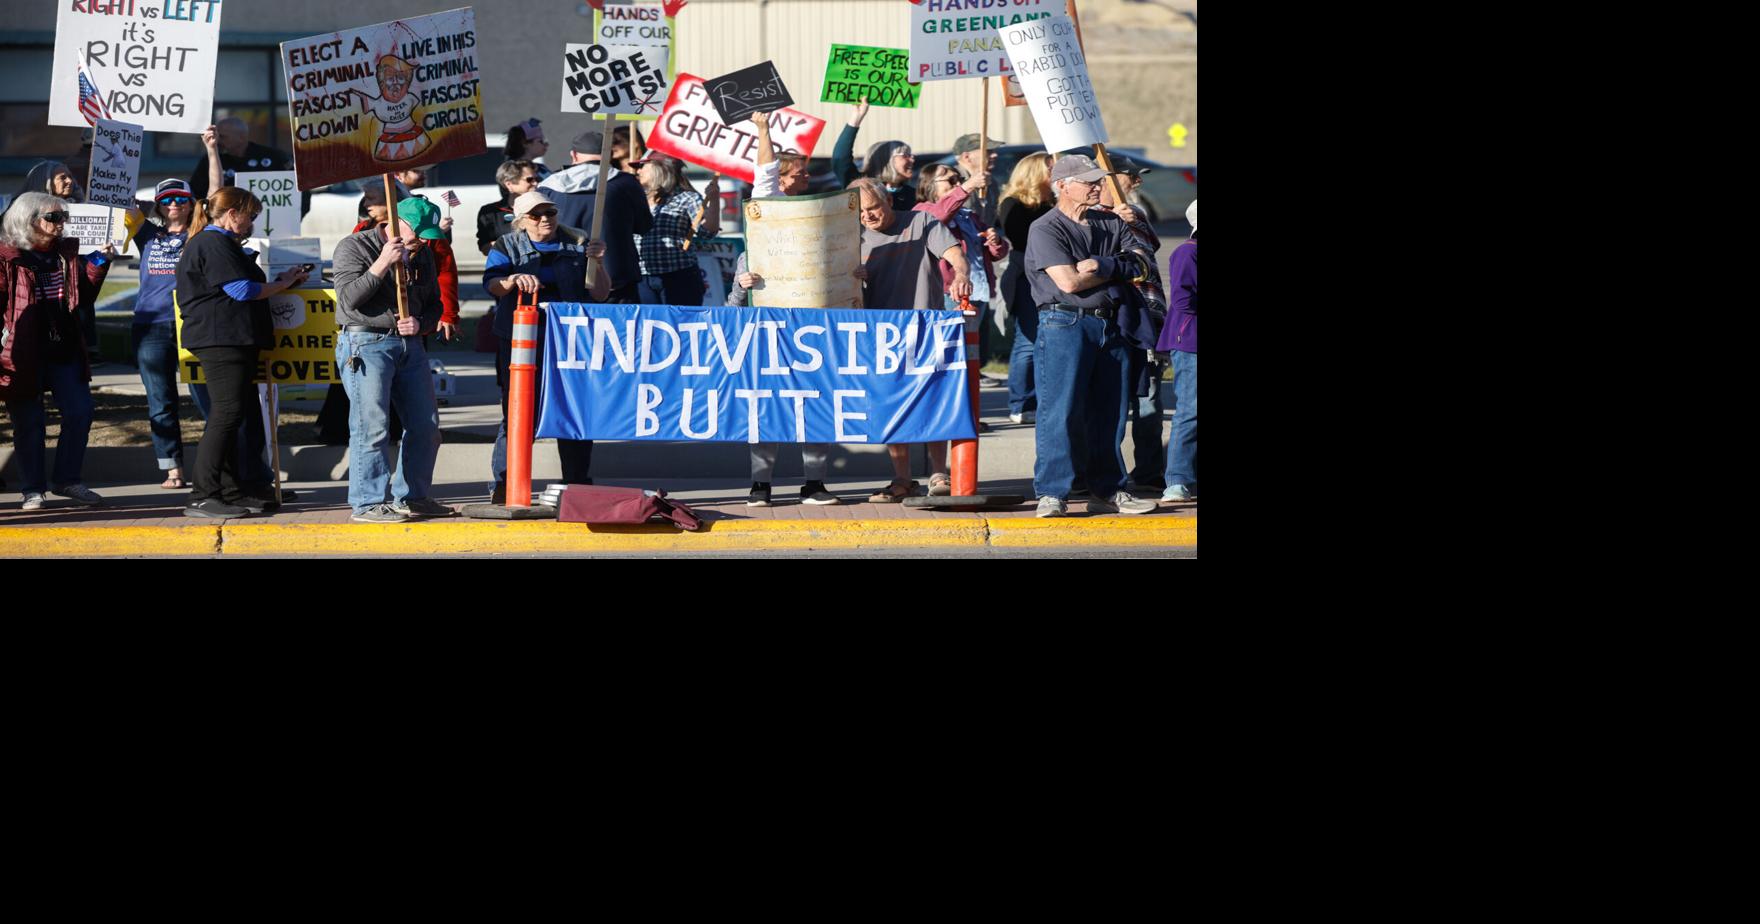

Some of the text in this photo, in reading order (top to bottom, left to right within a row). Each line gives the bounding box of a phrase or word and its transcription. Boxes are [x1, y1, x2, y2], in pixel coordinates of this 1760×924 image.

[139, 6, 160, 19] vs
[162, 0, 220, 23] LEFT
[602, 7, 659, 21] HANDS
[122, 22, 155, 43] it's
[601, 26, 672, 39] OFF OUR
[1008, 25, 1046, 45] ONLY
[86, 40, 198, 72] RIGHT
[289, 36, 369, 67] ELECT A
[402, 31, 475, 60] LIVE IN HIS
[949, 37, 1004, 54] PANA
[1043, 42, 1073, 54] FOR A
[565, 44, 608, 73] NO
[832, 48, 870, 66] FREE
[1017, 54, 1066, 76] RABID
[118, 72, 148, 86] vs
[291, 61, 374, 92] CRIMINAL
[416, 56, 478, 82] CRIMINAL
[565, 52, 650, 96] MORE
[843, 69, 903, 87] IS OUR
[920, 60, 988, 78] PUBLIC
[420, 79, 480, 107] FASCIST
[579, 69, 667, 113] CUTS!
[713, 67, 781, 112] Resist
[826, 81, 914, 107] FREEDOM
[293, 90, 352, 117] FASCIST
[1047, 93, 1074, 109] PUT
[423, 105, 479, 131] CIRCUS
[1061, 106, 1097, 124] DOW
[97, 125, 141, 143] Does This
[295, 114, 358, 142] CLOWN
[93, 166, 132, 184] Make My
[249, 179, 294, 192] FOOD
[89, 190, 110, 203] Look
[90, 179, 131, 195] Country
[260, 194, 292, 207] ANK
[307, 300, 335, 313] TH
[557, 316, 967, 376] INDIVISIBLE
[635, 383, 868, 444] BUTTE
